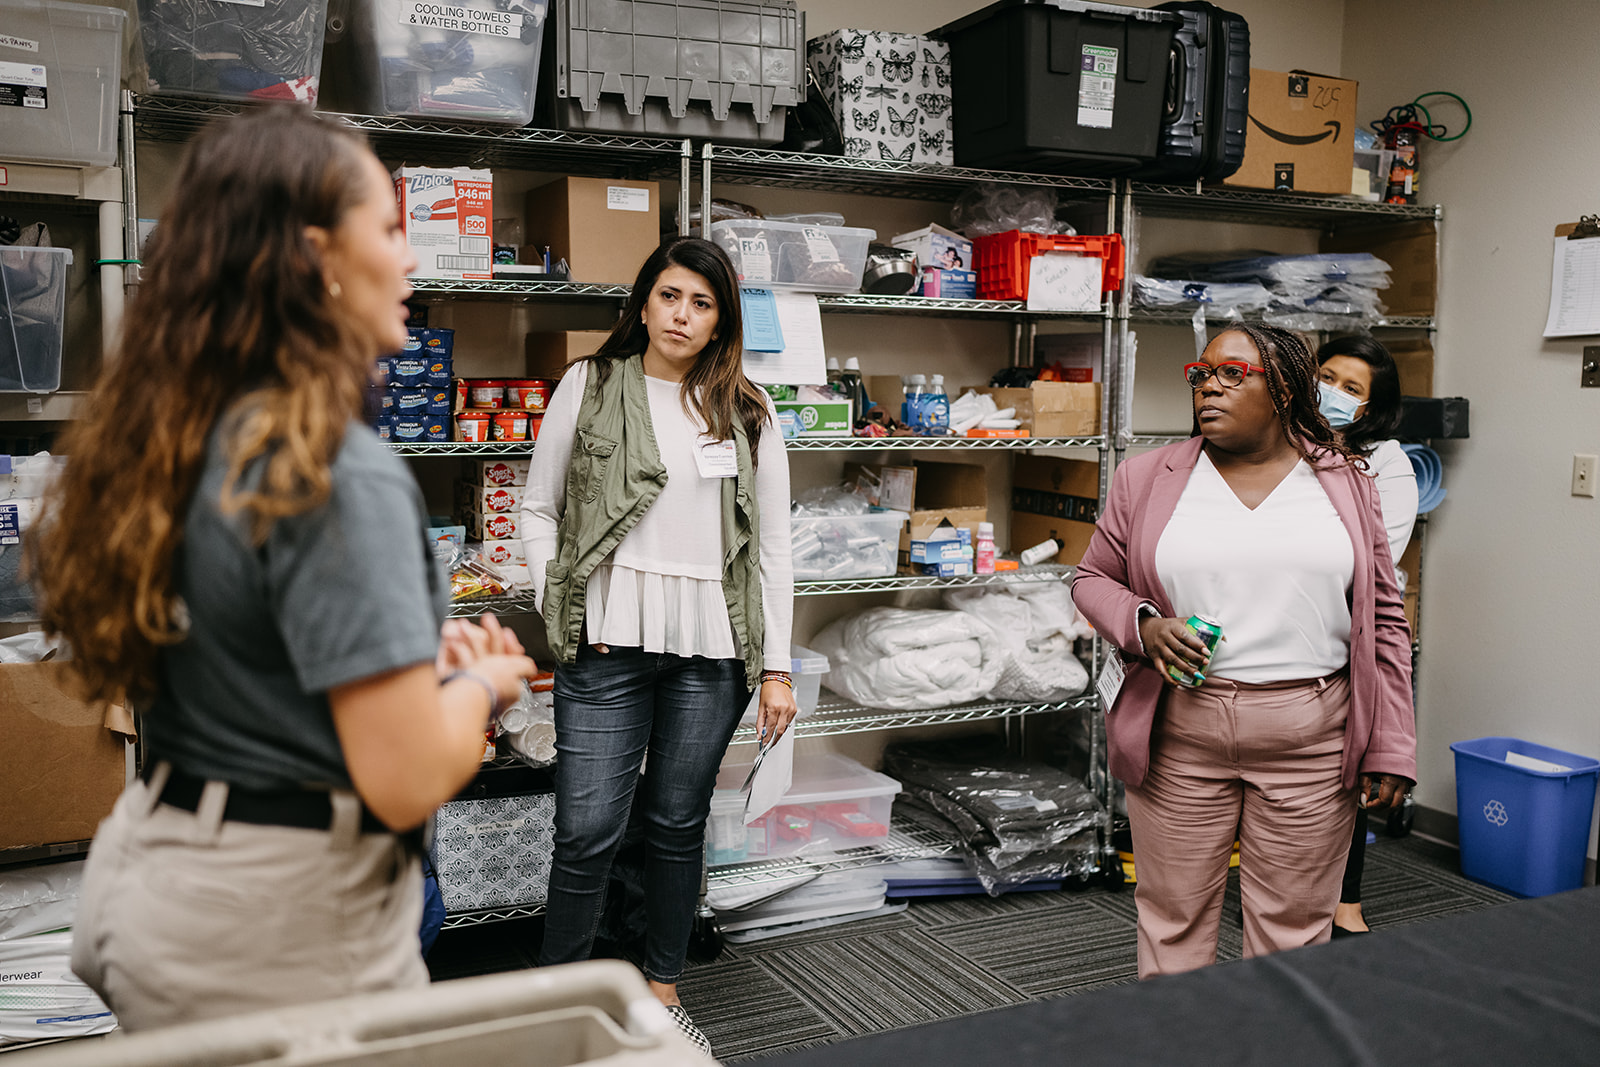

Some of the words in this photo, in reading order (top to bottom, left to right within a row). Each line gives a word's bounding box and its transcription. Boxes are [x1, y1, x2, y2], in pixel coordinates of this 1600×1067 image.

[415, 3, 464, 18] COOLING
[467, 9, 511, 24] TOWELS
[410, 13, 417, 24] &
[420, 15, 459, 29] WATER
[461, 20, 509, 36] BOTTLES
[9, 38, 32, 49] PANTS
[411, 174, 453, 194] Ziploc
[458, 188, 478, 200] 946
[479, 190, 491, 200] ml
[467, 220, 485, 229] 500
[489, 469, 512, 478] Snack
[489, 494, 513, 505] Snack
[490, 520, 513, 531] Snack
